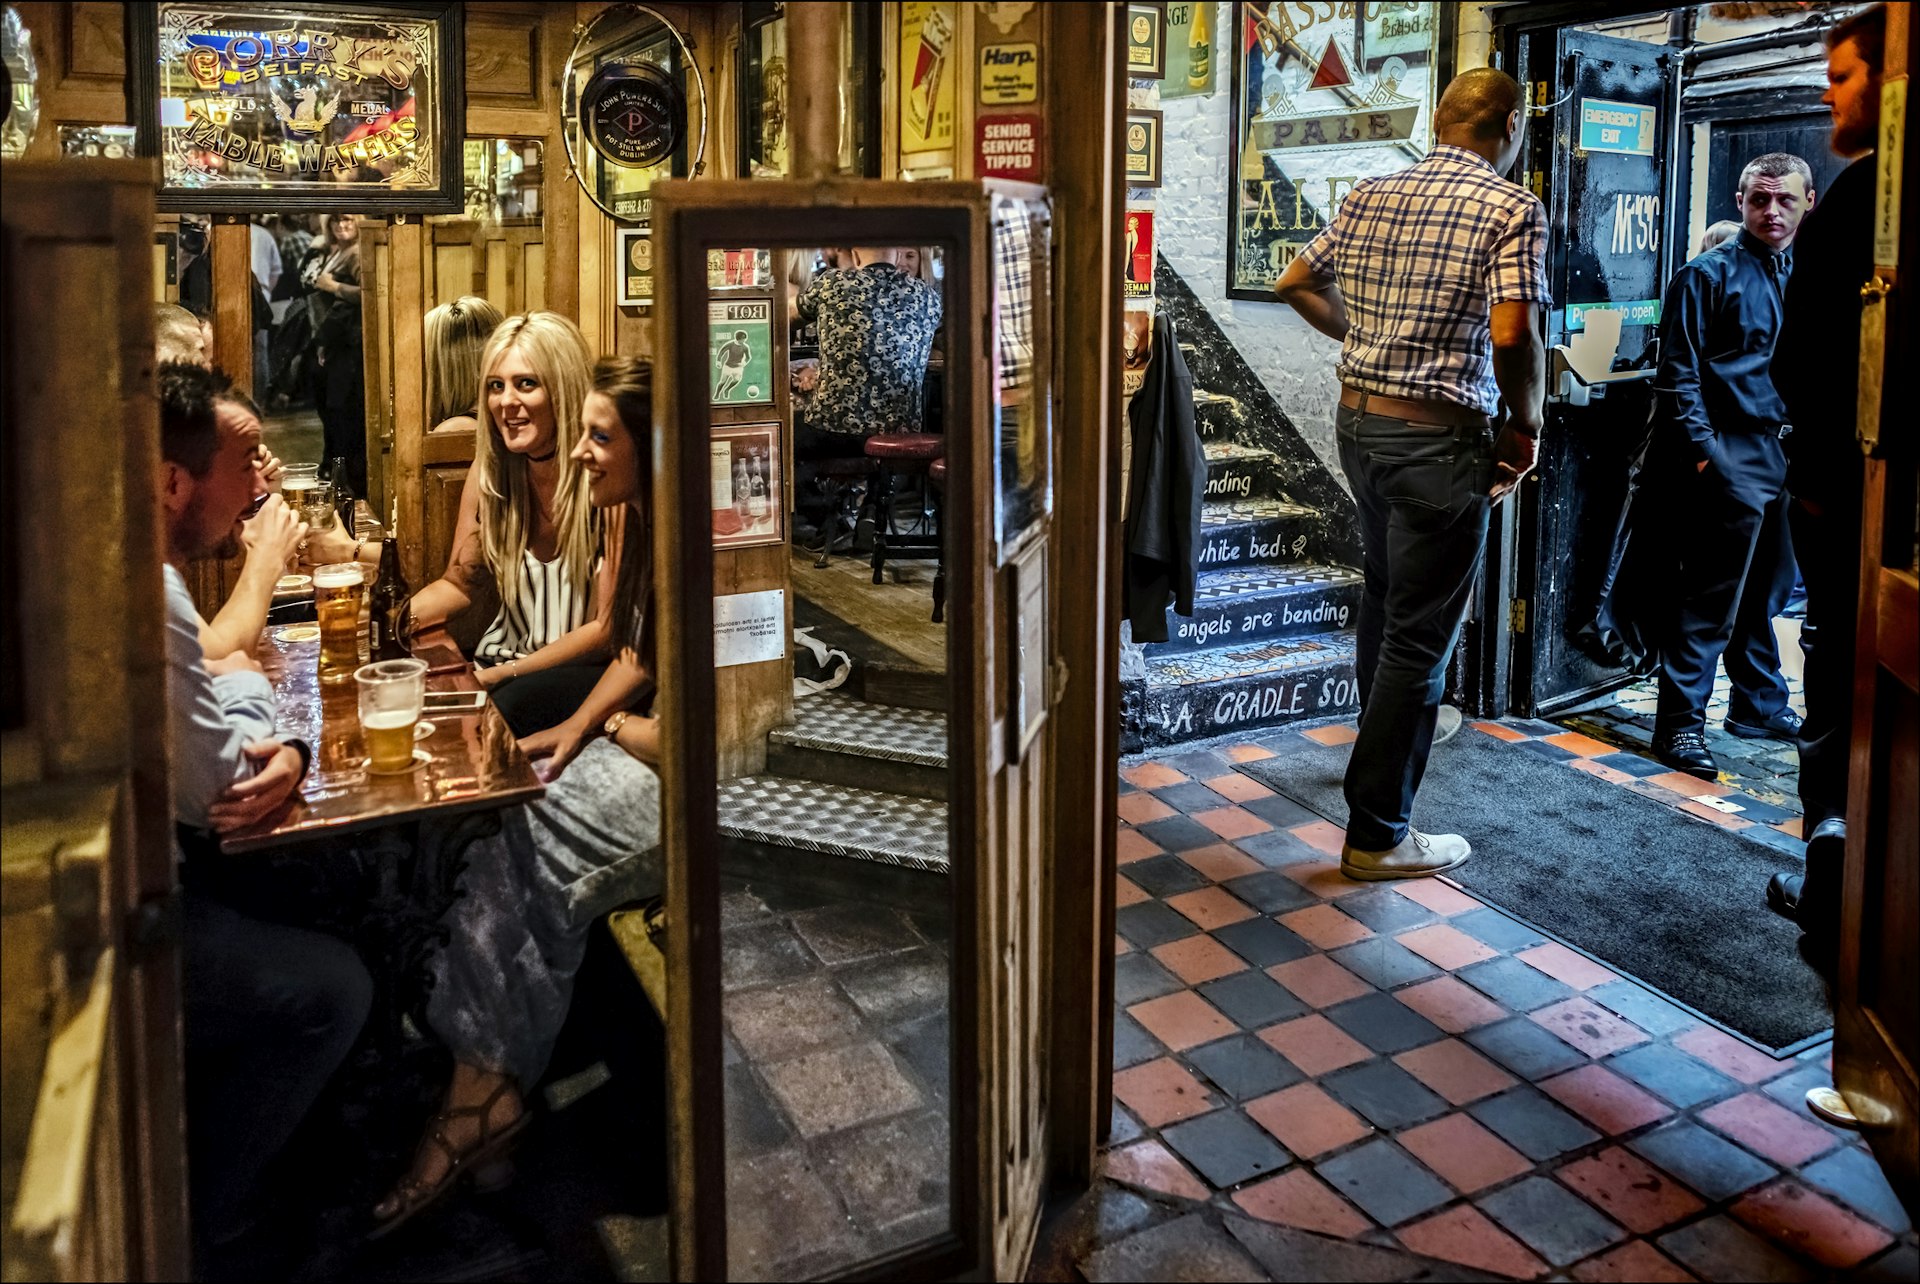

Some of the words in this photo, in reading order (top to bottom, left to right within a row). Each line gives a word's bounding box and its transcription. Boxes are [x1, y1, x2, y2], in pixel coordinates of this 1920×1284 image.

[984, 47, 1035, 67] Harp.
[241, 62, 369, 87] BELFAST
[351, 102, 389, 115] MEDAL
[600, 95, 620, 112] JOHN
[628, 112, 643, 131] P
[1585, 108, 1638, 127] EMERGENCY
[984, 123, 1031, 139] SENIOR
[1272, 113, 1394, 147] PALE
[181, 110, 286, 172] TABLE
[297, 116, 420, 173] WATERS
[605, 134, 618, 146] POT
[618, 142, 634, 151] STILL
[635, 136, 662, 151] WHISKEY
[982, 138, 1035, 154] SERVICE
[620, 150, 645, 158] DUBLIN
[985, 154, 1032, 170] TIPPED
[1248, 176, 1358, 230] ALE
[1632, 305, 1654, 322] open
[1177, 614, 1232, 645] angels
[1242, 612, 1273, 632] are
[1283, 600, 1350, 628] bending
[1214, 683, 1307, 724] CRADLE
